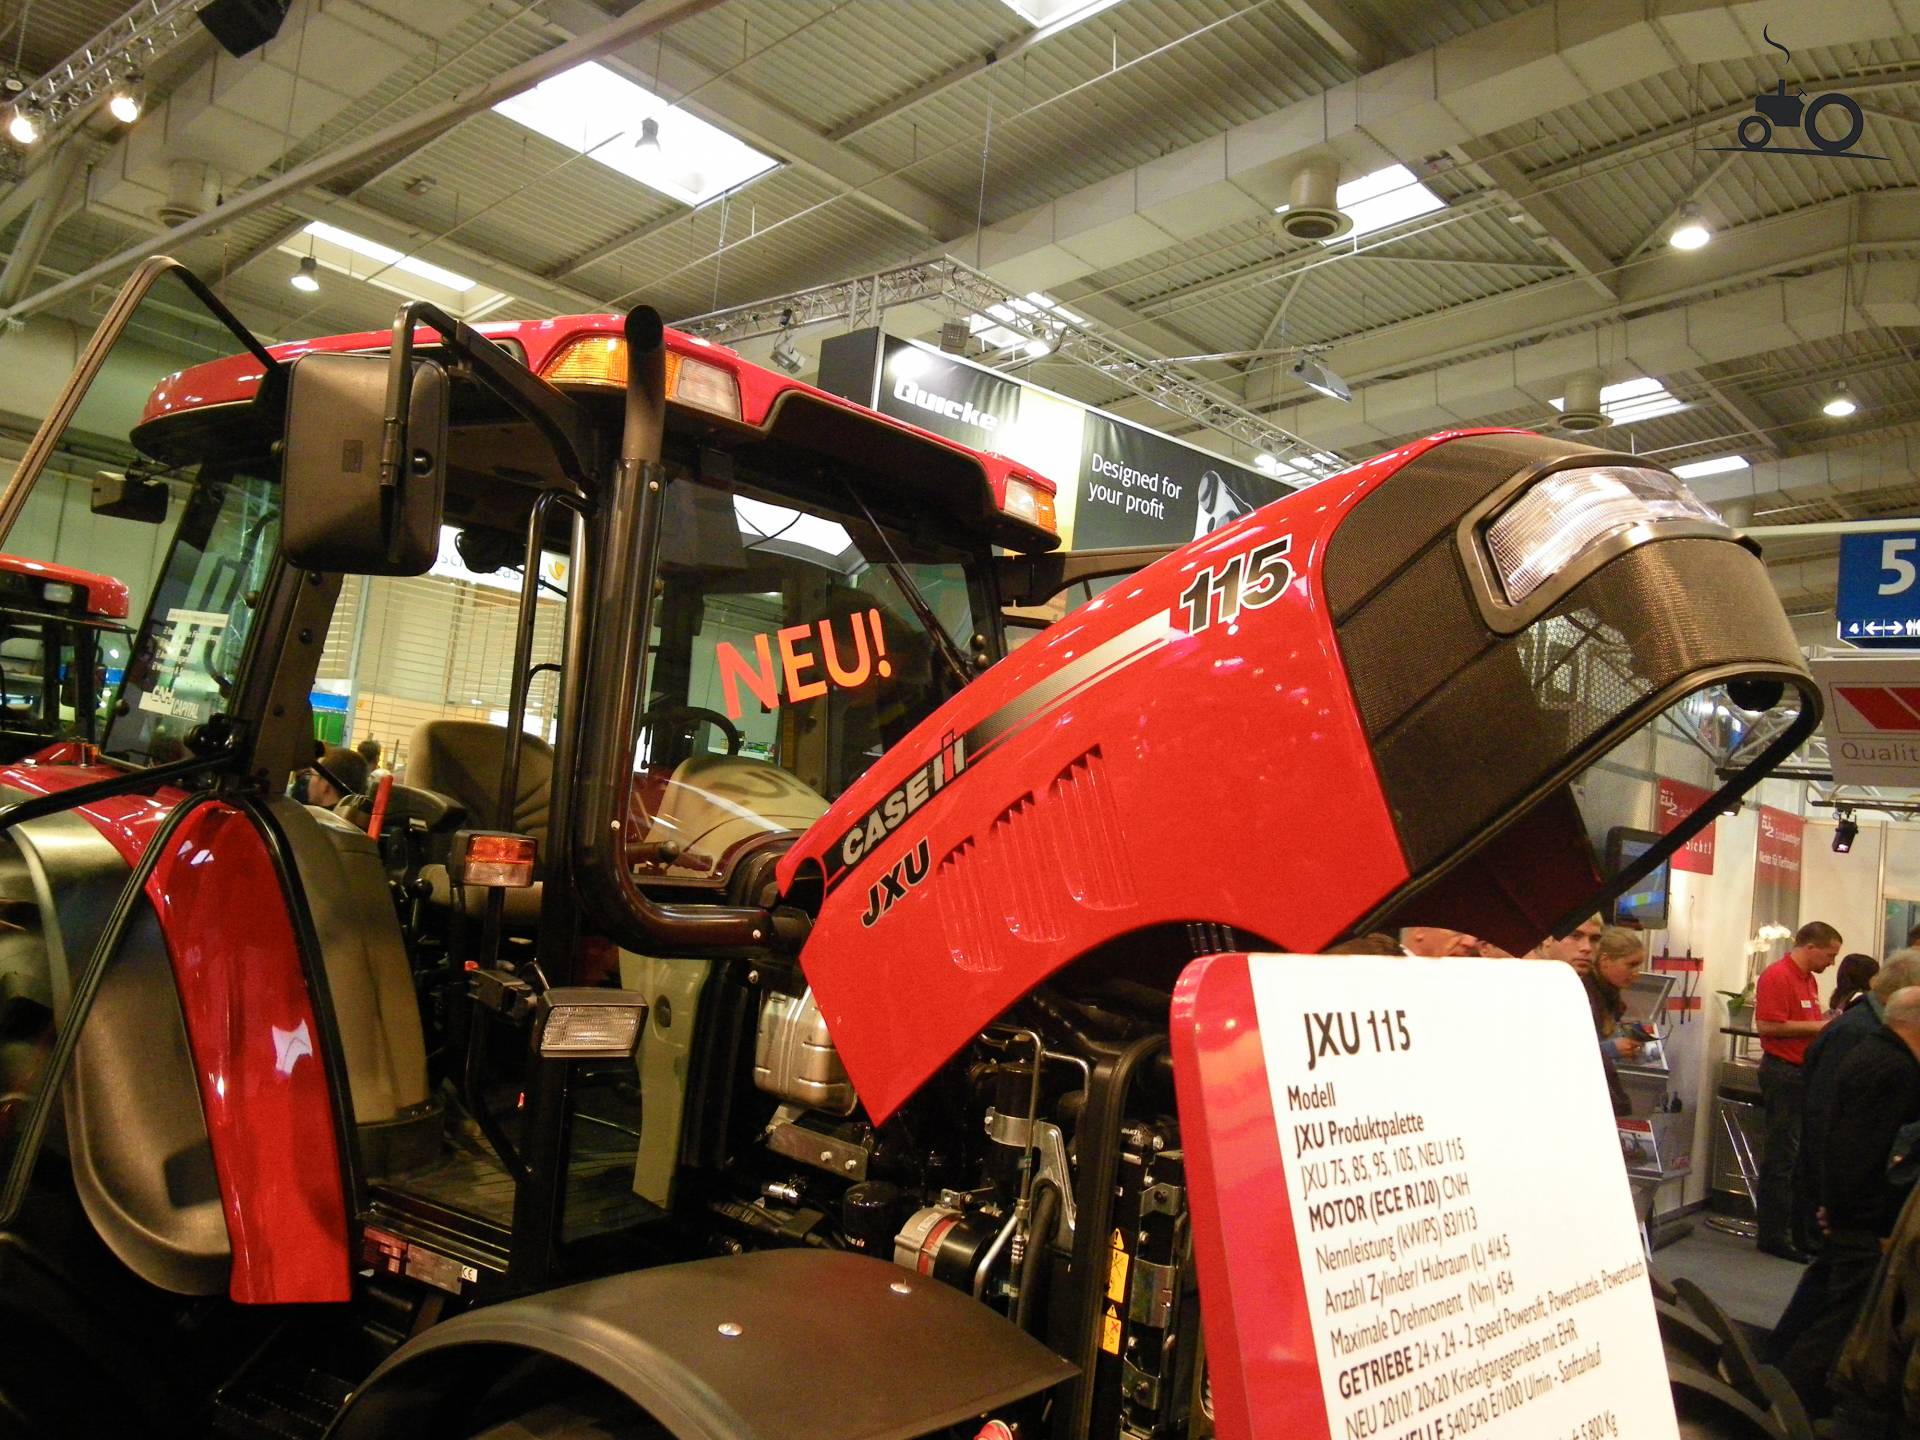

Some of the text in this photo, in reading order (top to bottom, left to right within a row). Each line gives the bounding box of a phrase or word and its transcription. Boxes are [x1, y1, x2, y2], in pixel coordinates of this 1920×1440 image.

[894, 379, 998, 431] Quicke
[1088, 481, 1165, 520] your profit
[1092, 453, 1182, 499] Designed for
[1180, 534, 1294, 635] 115
[1878, 538, 1917, 596] 5
[1849, 622, 1860, 634] 4
[716, 608, 892, 720] NEU!
[860, 835, 932, 928] JXU
[1304, 1009, 1411, 1071] JXU 115
[1287, 1082, 1336, 1111] Modell
[1294, 1112, 1425, 1159] JXU Produktpalette
[1301, 1137, 1465, 1200] JXU 75, 85, 95, 105, NEU 115
[1308, 1172, 1471, 1233] MOTOR (ECE R120) CNH
[1315, 1206, 1479, 1274] Nennleistung (kW/PS) 83/113
[1325, 1278, 1366, 1316] Anzahl
[1420, 1255, 1470, 1284] Hubraum
[1471, 1242, 1487, 1272] (L)
[1487, 1233, 1511, 1262] 4/4,5
[1330, 1269, 1514, 1359] Maximale Drehmoment (Nm) 454
[1338, 1345, 1414, 1399] GETRIEBE
[1415, 1340, 1431, 1369] 24
[1432, 1343, 1441, 1363] x
[1441, 1330, 1456, 1358] 24
[1464, 1323, 1474, 1348] 2
[1474, 1310, 1503, 1350] speed
[1345, 1317, 1578, 1440] NEU 2010! 20x20 Kriechganggetriebe mit EHR
